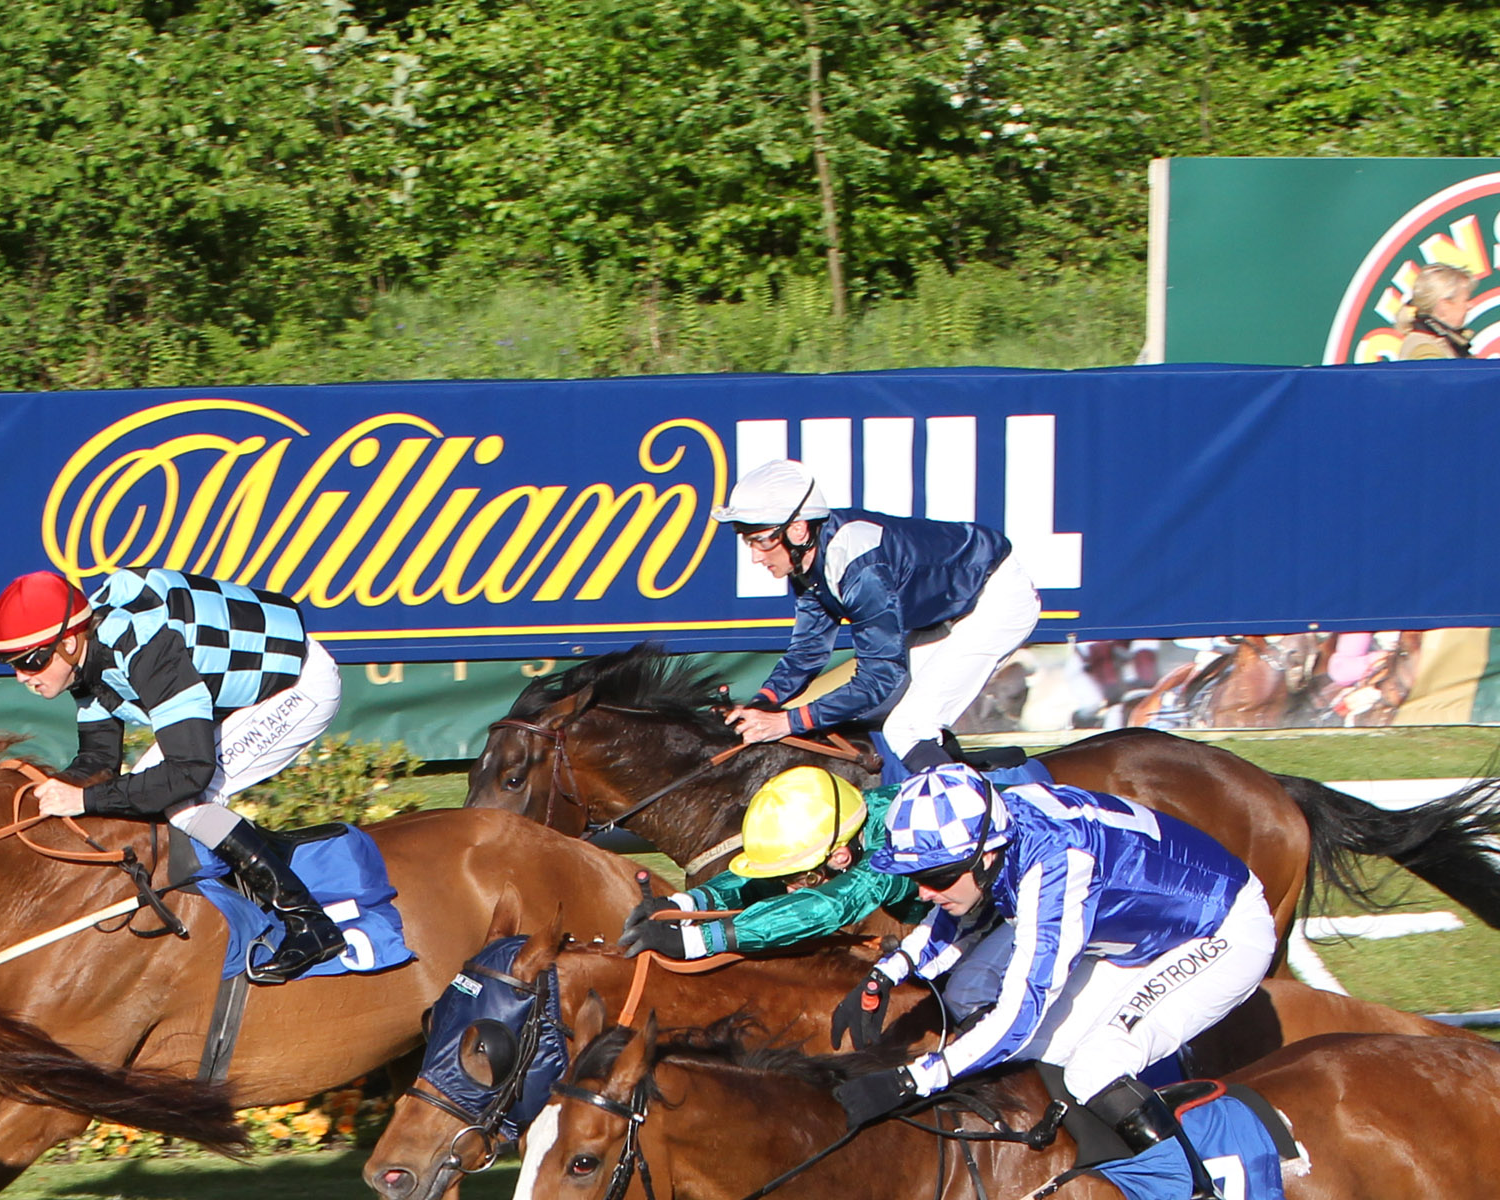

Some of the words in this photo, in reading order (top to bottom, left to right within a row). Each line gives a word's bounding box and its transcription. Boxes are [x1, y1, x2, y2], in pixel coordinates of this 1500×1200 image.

[42, 398, 729, 608] William
[218, 726, 263, 765] CROWN
[260, 691, 303, 731] TAVERN
[248, 720, 292, 758] LANARK
